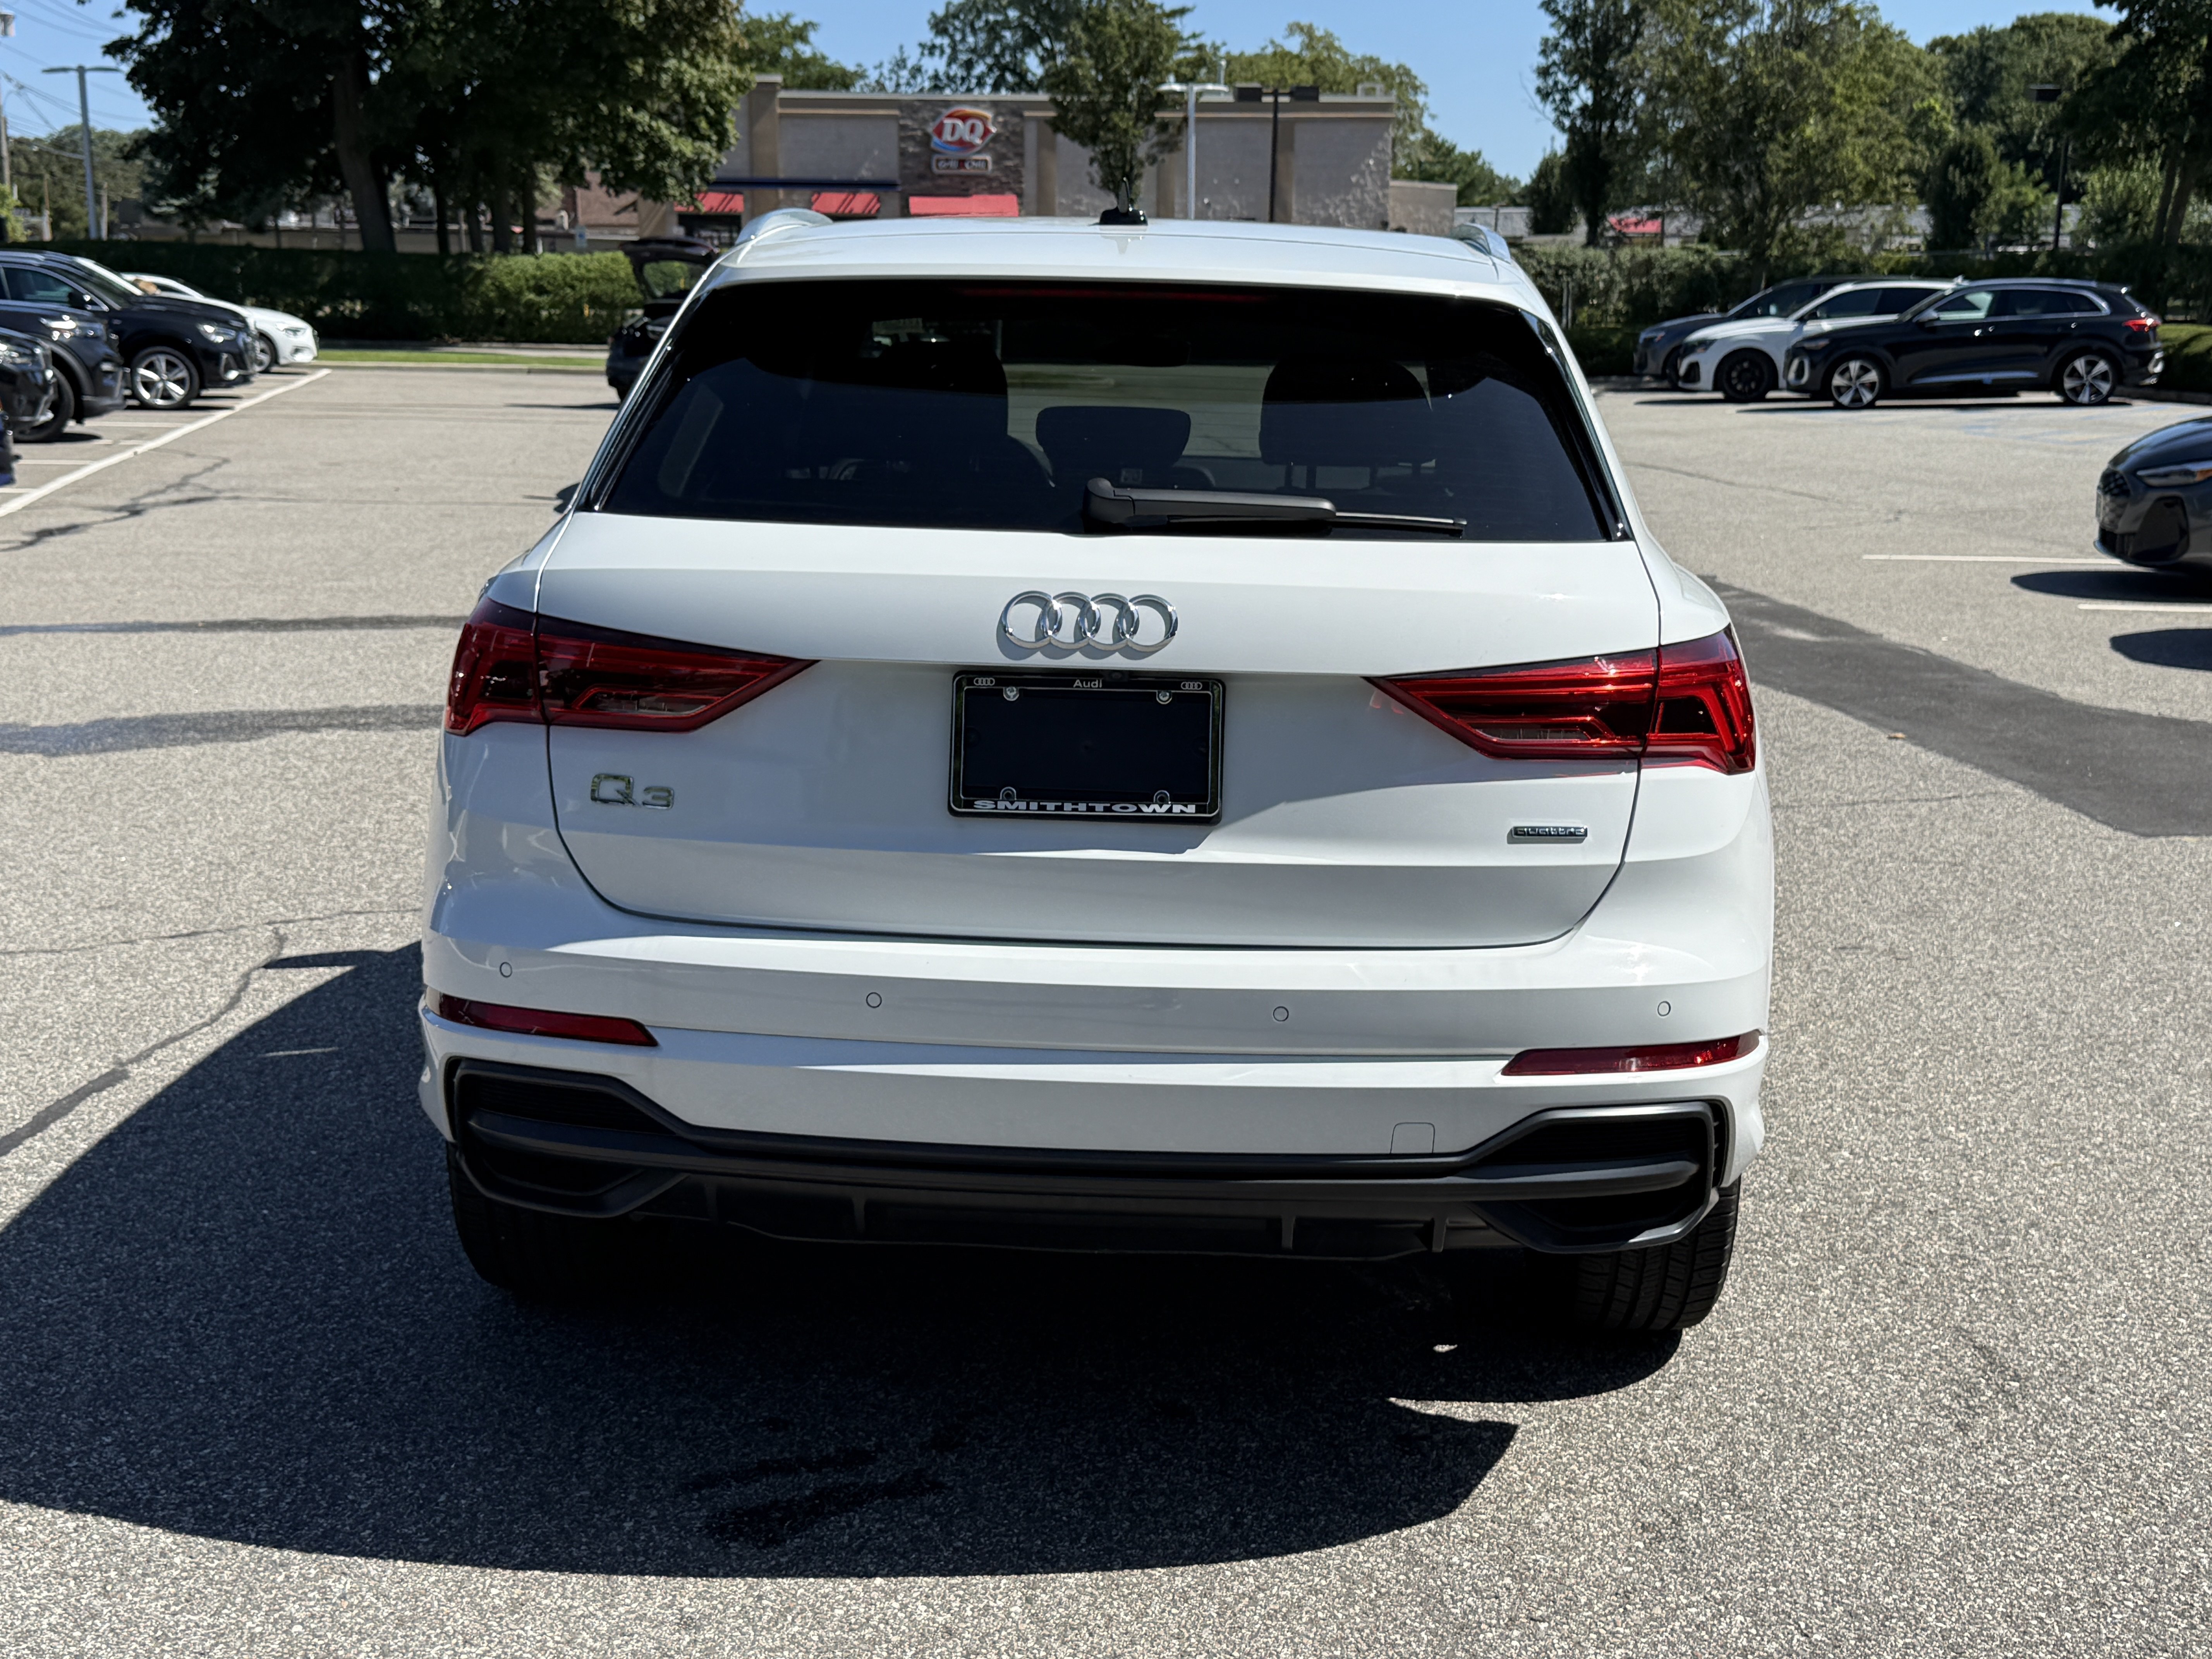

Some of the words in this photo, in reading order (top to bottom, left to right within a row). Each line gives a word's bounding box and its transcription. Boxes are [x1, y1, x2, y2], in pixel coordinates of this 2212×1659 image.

[942, 118, 984, 144] DQ
[1073, 679, 1102, 688] Audi
[591, 773, 675, 810] Q3
[974, 800, 1195, 813] SMITHTOWN
